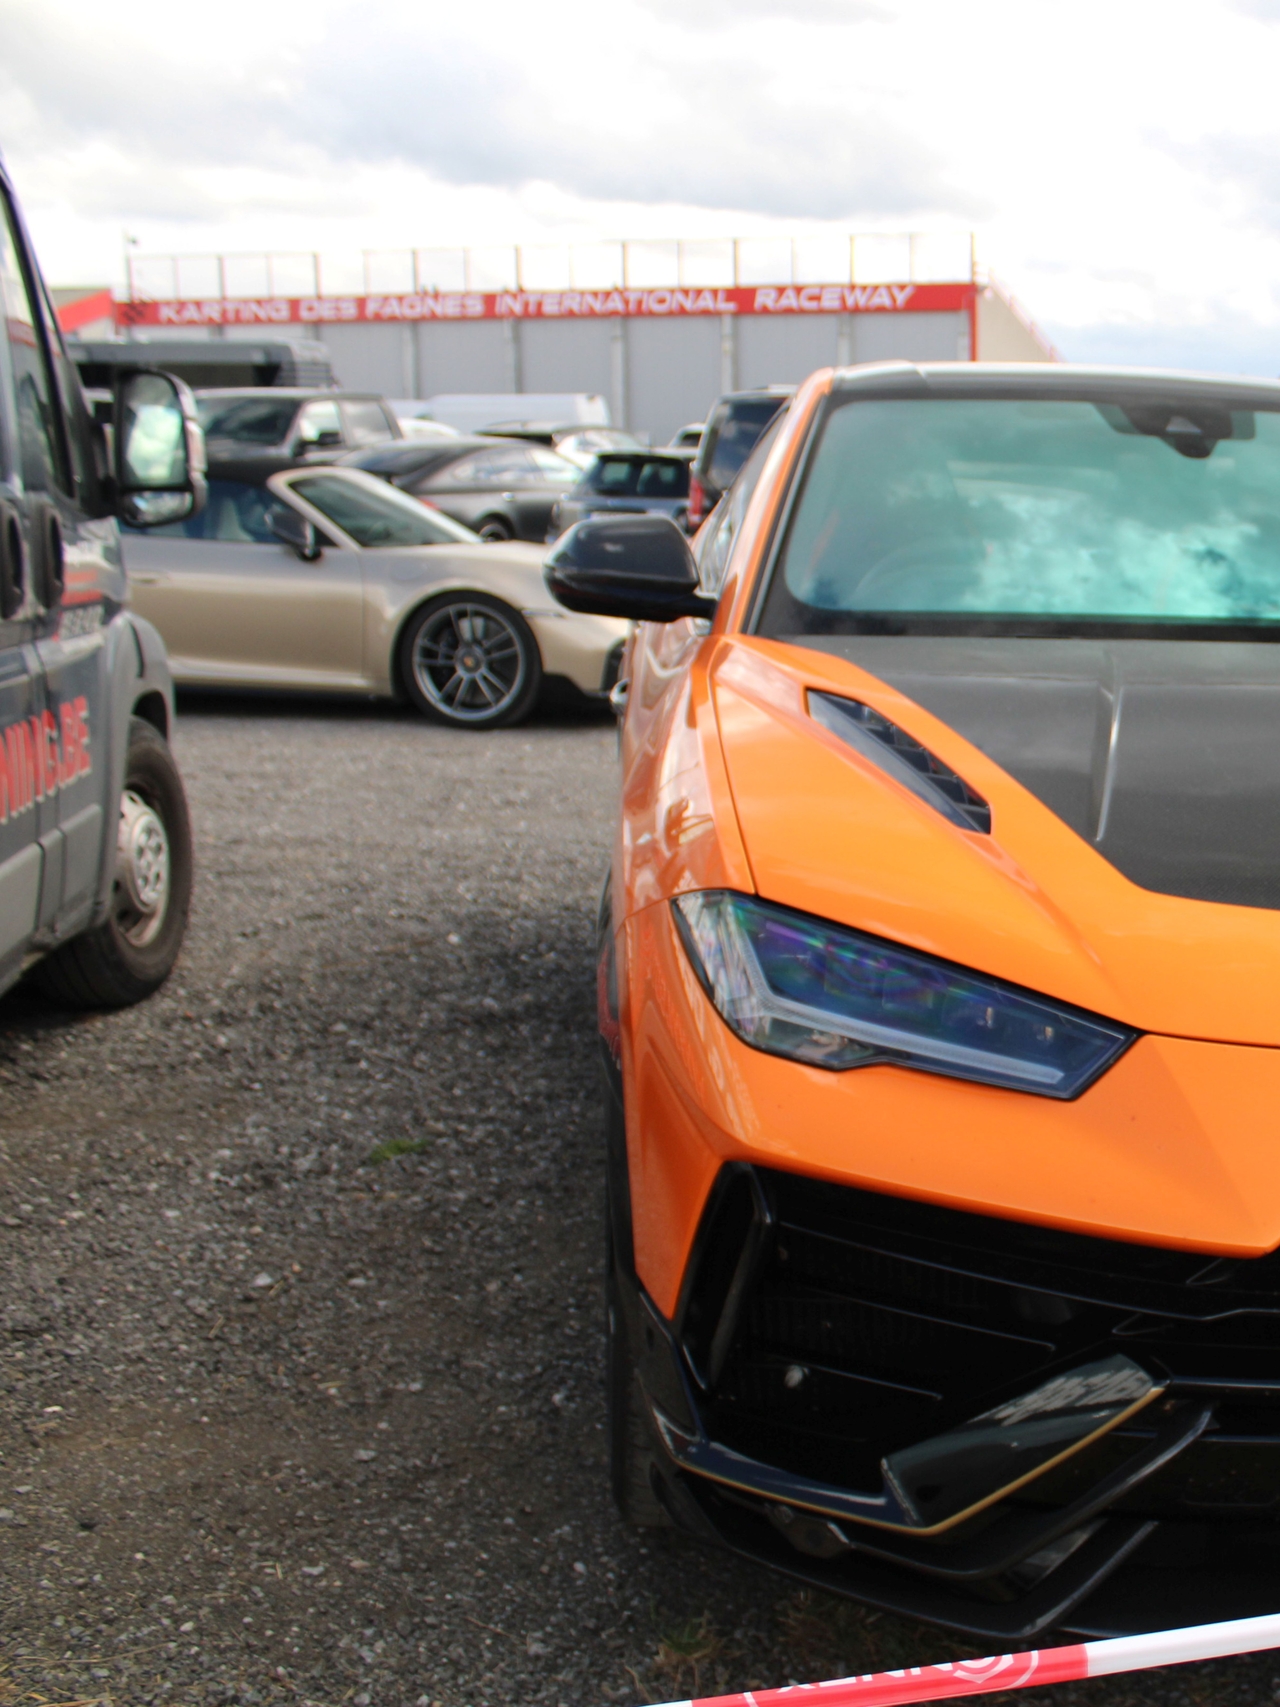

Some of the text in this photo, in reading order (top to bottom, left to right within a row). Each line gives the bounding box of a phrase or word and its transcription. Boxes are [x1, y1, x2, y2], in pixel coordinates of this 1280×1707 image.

[159, 285, 916, 323] KARTING DES FAGNES INTERNATIONAL RACEWAY
